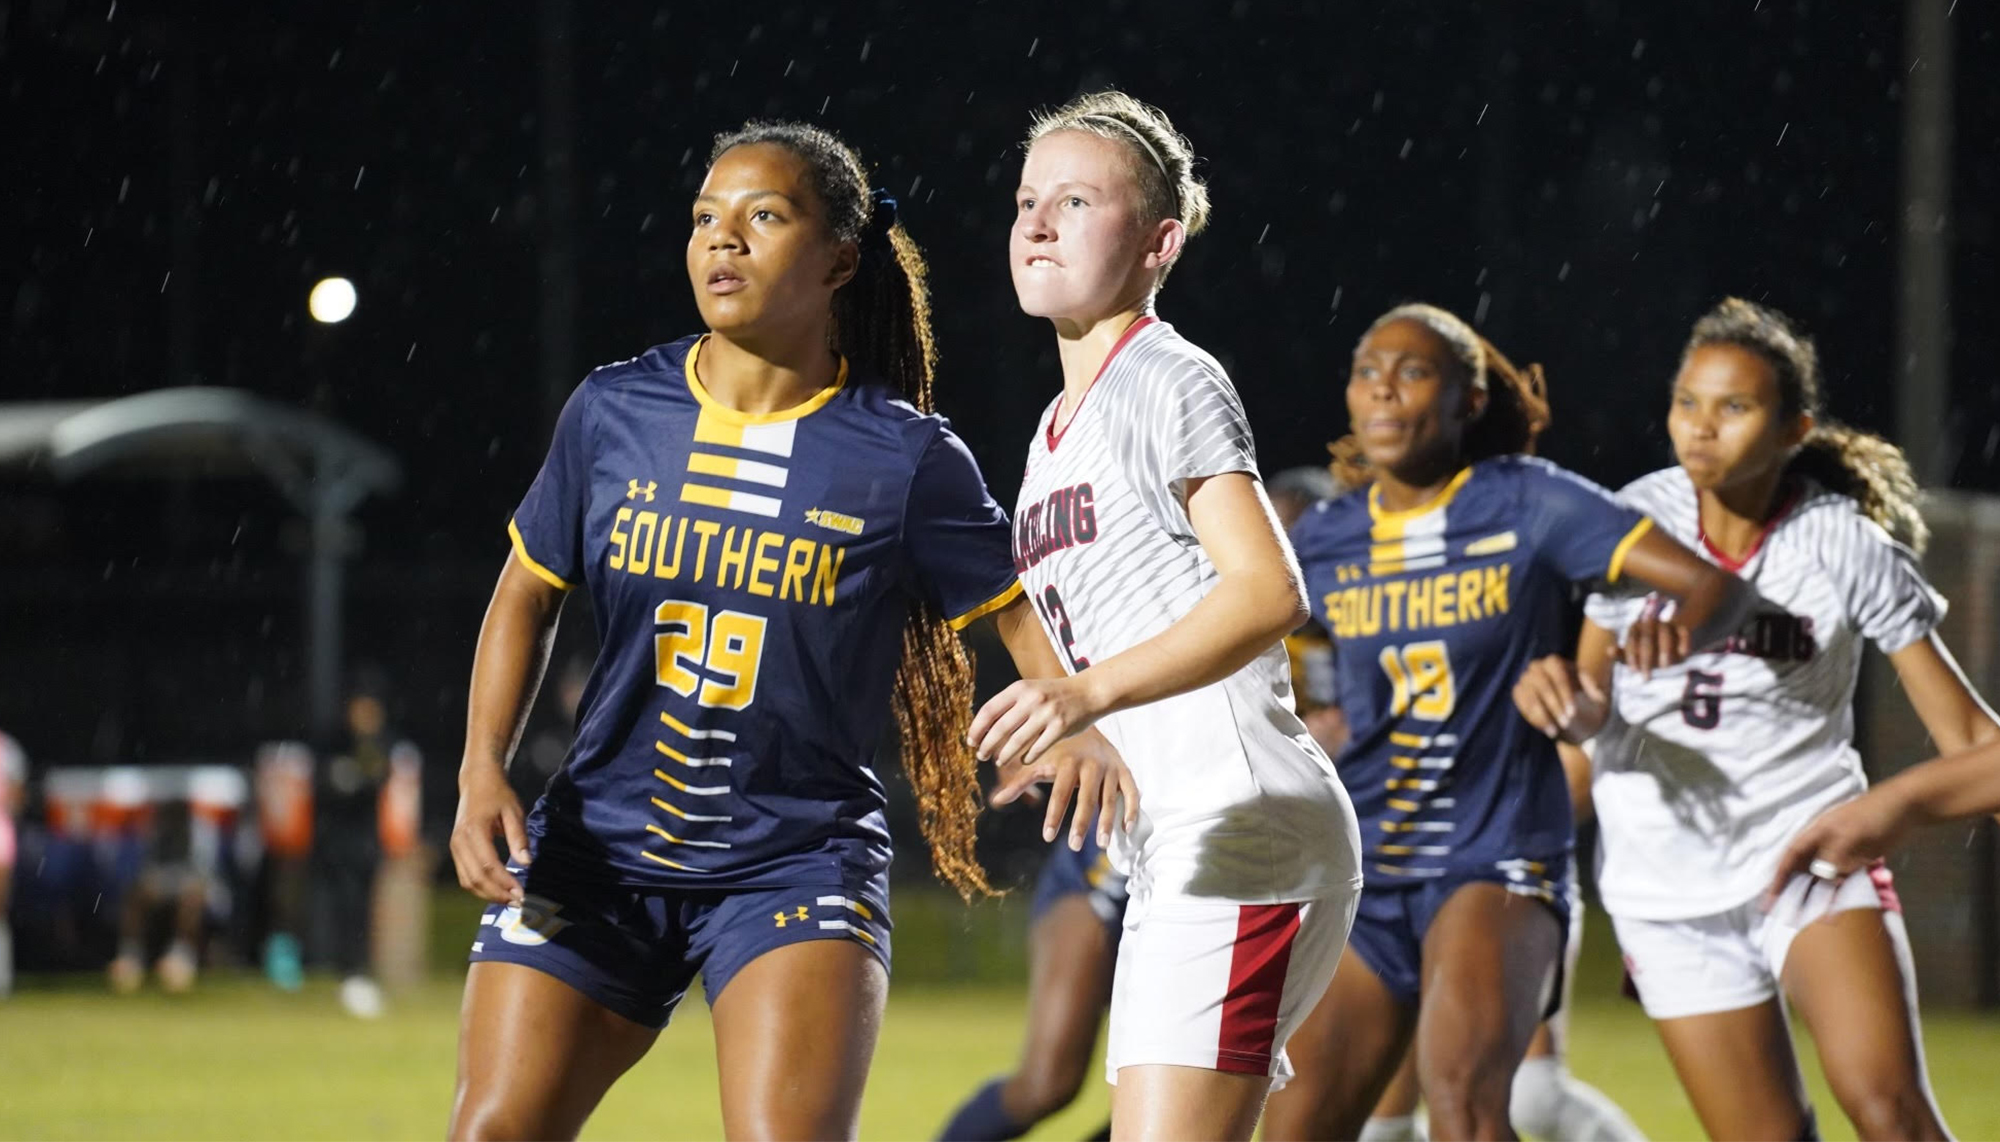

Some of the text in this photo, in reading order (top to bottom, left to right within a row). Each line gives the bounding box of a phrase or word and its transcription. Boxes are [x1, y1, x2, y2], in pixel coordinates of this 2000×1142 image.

[609, 508, 845, 607] SOUTHERN
[818, 509, 866, 536] SWAC
[1324, 563, 1511, 638] SOUTHERN
[654, 599, 768, 712] 29
[1378, 639, 1456, 722] 19
